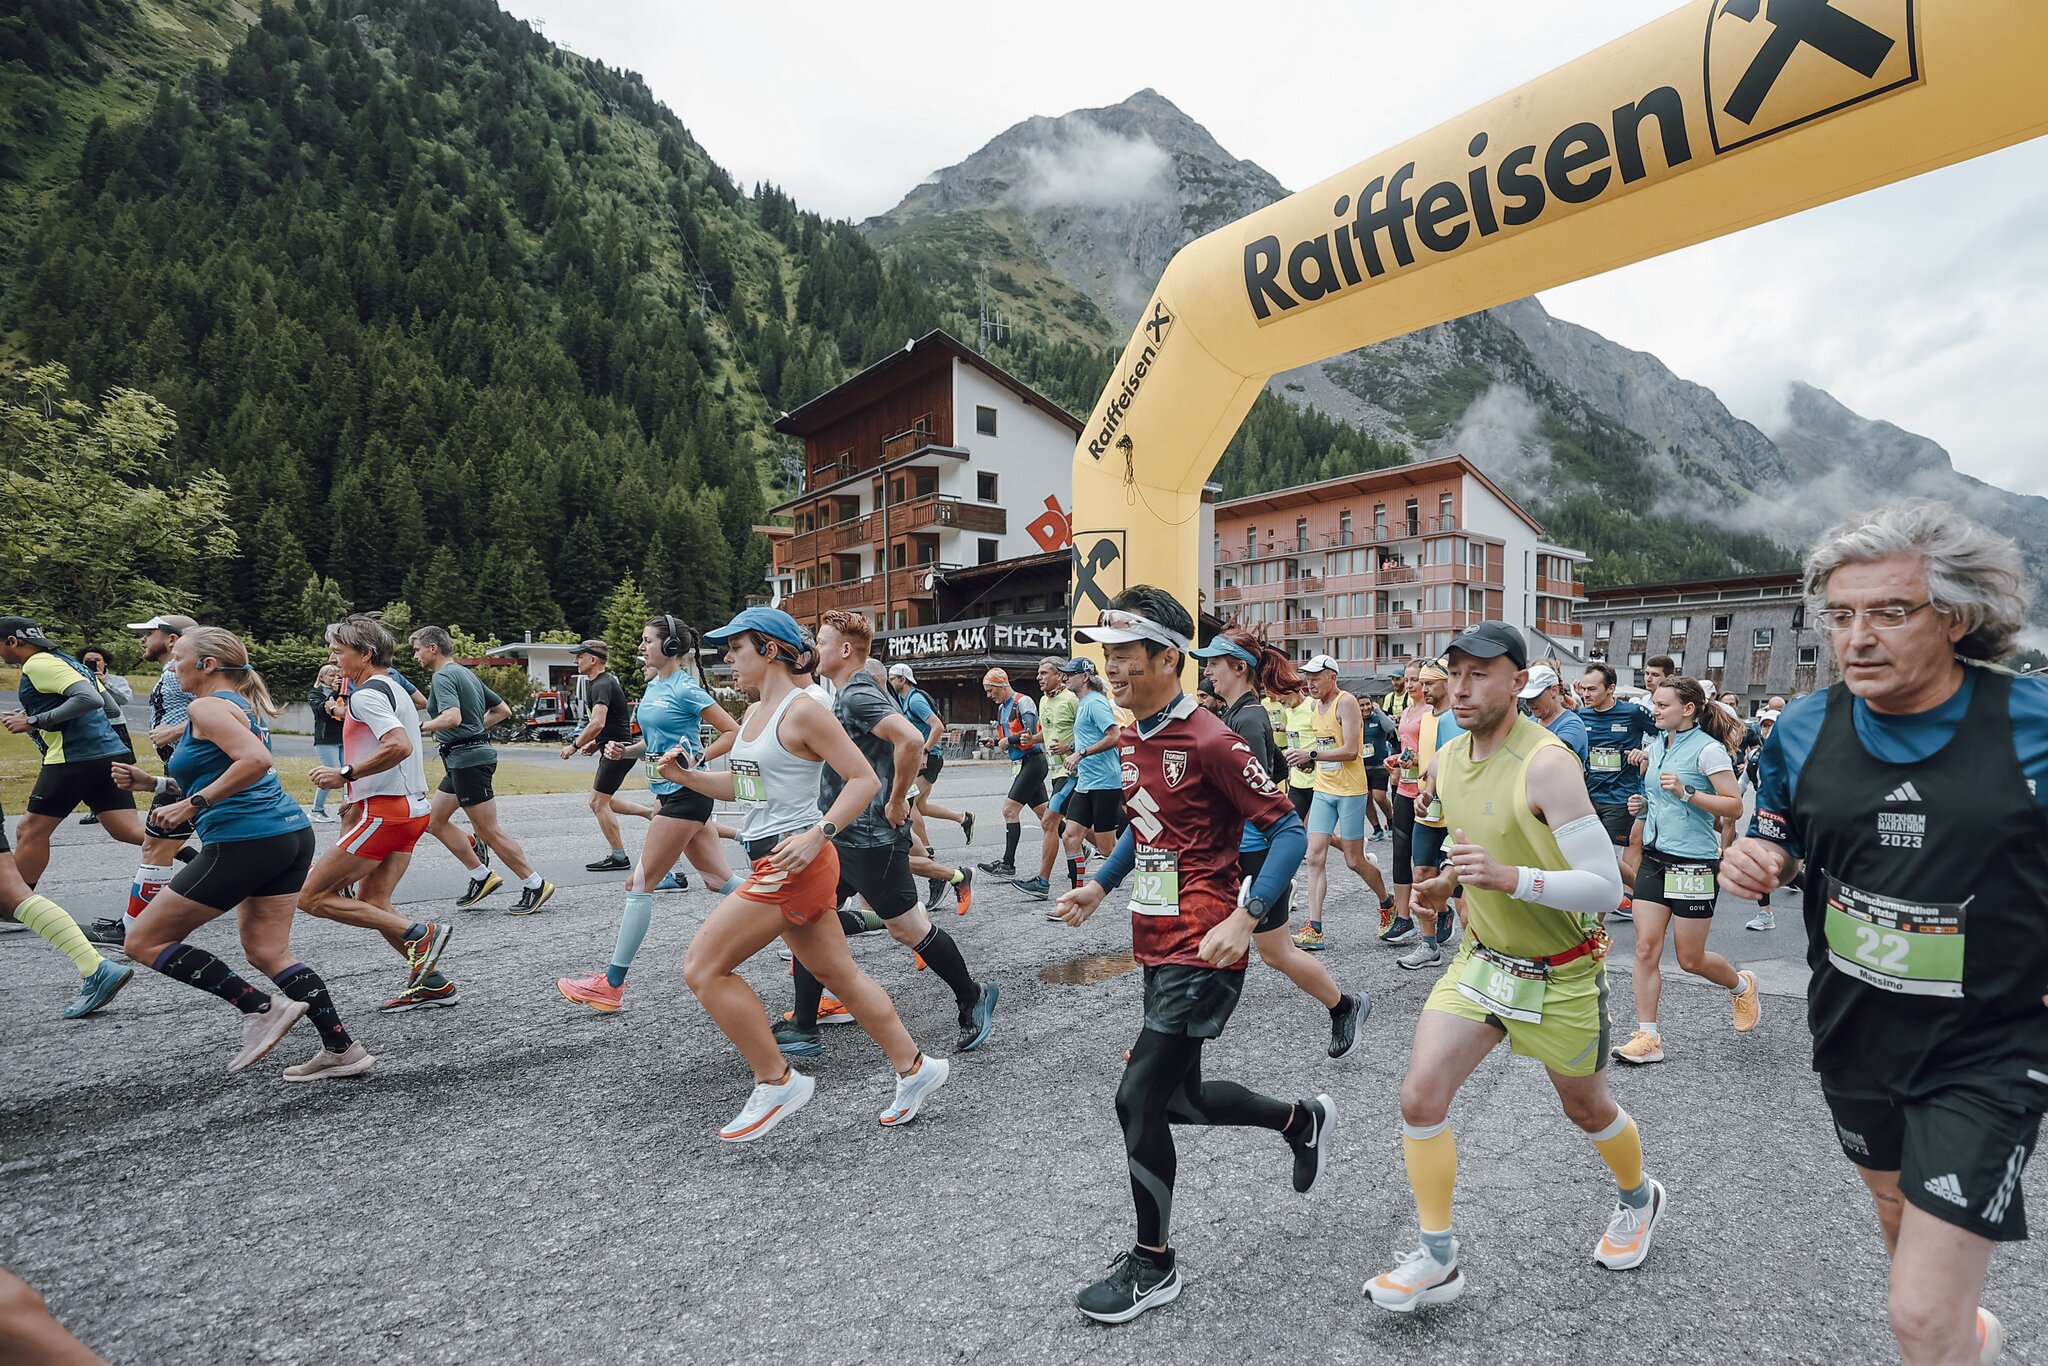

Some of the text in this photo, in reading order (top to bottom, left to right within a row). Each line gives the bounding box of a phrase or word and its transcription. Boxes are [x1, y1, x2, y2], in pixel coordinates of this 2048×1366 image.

[1243, 85, 1693, 320] Raiffeisen
[1088, 346, 1157, 460] Raiffeisen
[888, 626, 987, 656] PITZTALER ALM
[1166, 753, 1185, 761] TORINO
[1597, 755, 1609, 766] 41
[737, 777, 756, 798] 110
[1757, 816, 1774, 826] DAS
[1760, 810, 1786, 824] PITZTAL
[1877, 812, 1926, 824] STOCKHOLM
[1758, 821, 1780, 834] DACH
[1758, 827, 1786, 840] TIROLS
[1877, 821, 1926, 834] MARATHON
[1880, 834, 1922, 848] 2023
[1675, 876, 1705, 892] 143
[1841, 886, 1852, 898] 17.
[1852, 891, 1940, 916] Gletschermarathon
[1868, 905, 1898, 921] Pitztal
[1913, 915, 1958, 925] 02. Juli 2023
[1855, 926, 1911, 973] 22
[1487, 971, 1516, 1003] 95
[1859, 969, 1904, 991] Massimo
[1924, 1180, 1968, 1208] adidas
